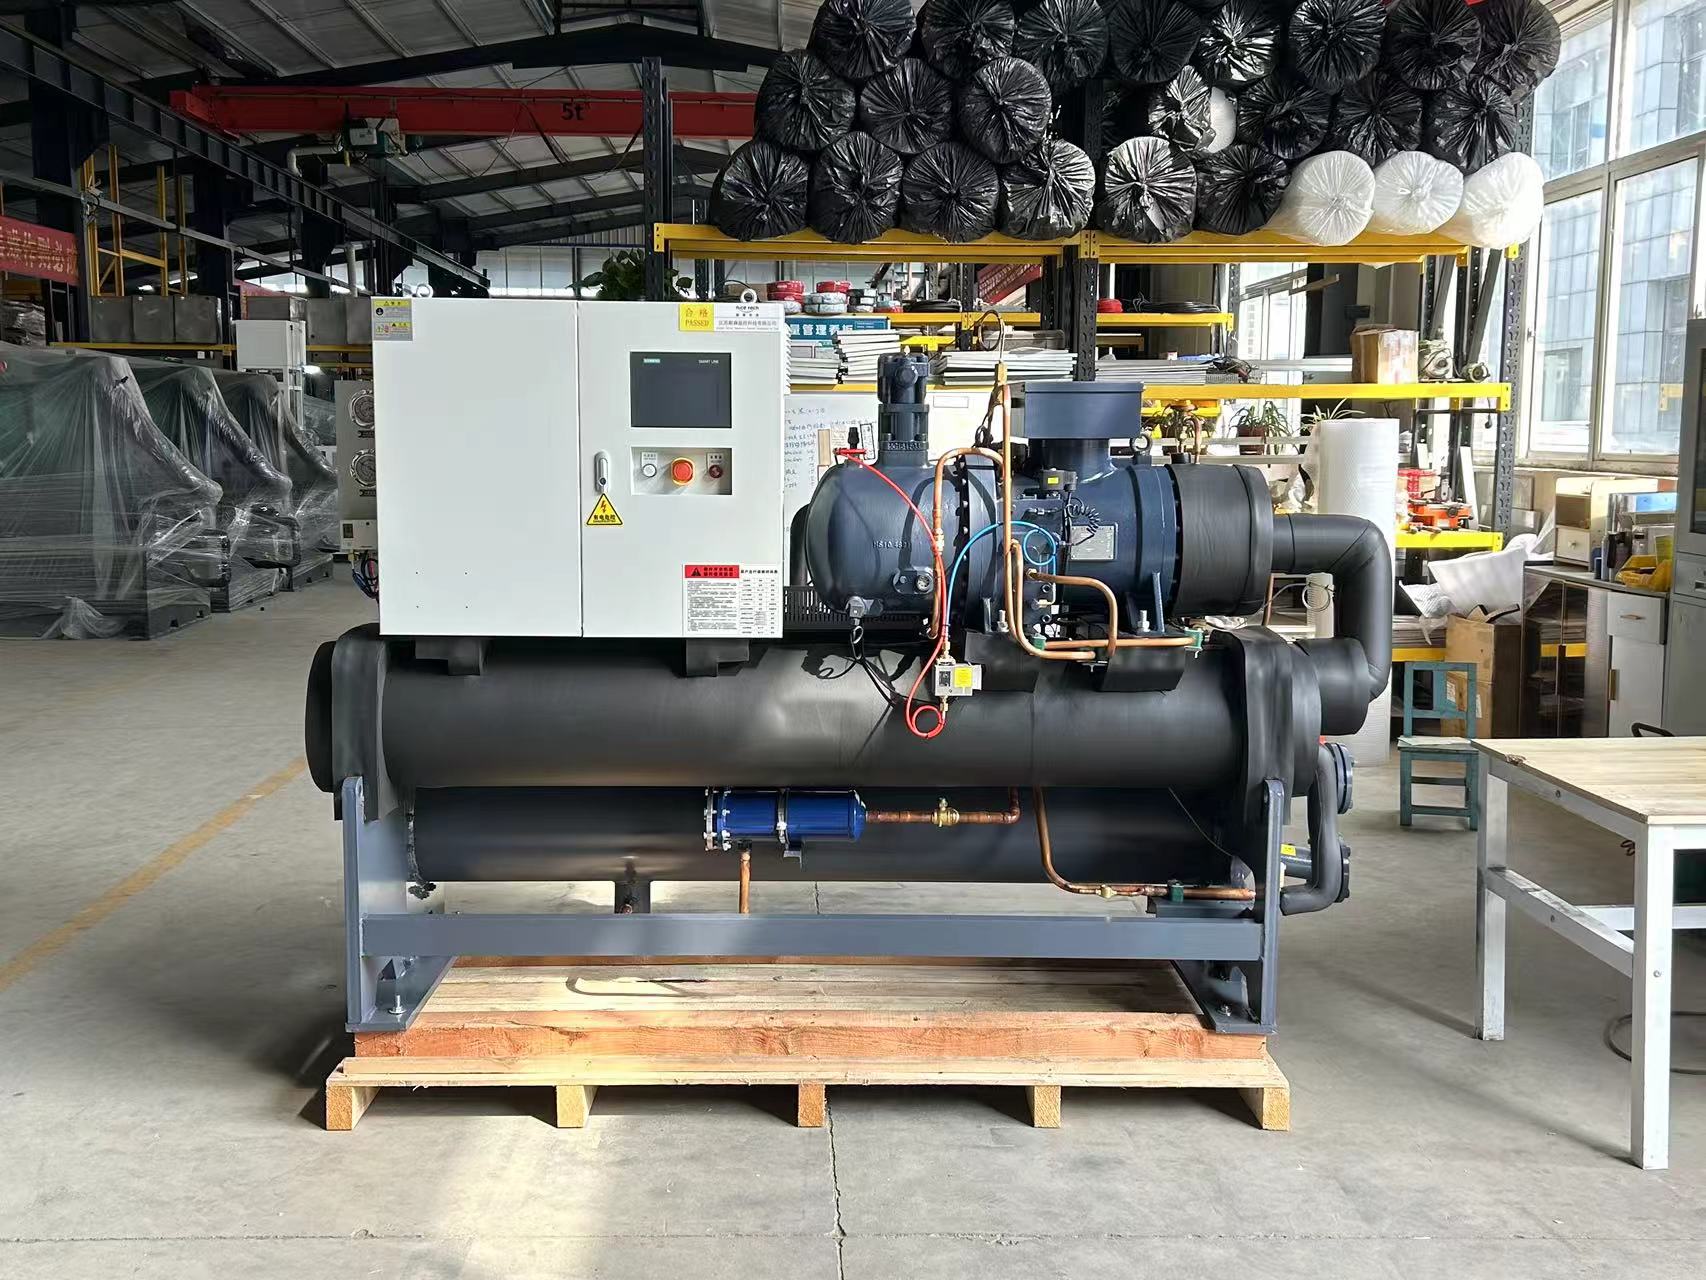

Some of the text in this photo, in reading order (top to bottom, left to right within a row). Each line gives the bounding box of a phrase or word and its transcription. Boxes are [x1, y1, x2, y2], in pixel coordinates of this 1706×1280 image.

[561, 102, 585, 121] 5t
[685, 307, 709, 318] 合格
[685, 319, 710, 328] PASSED
